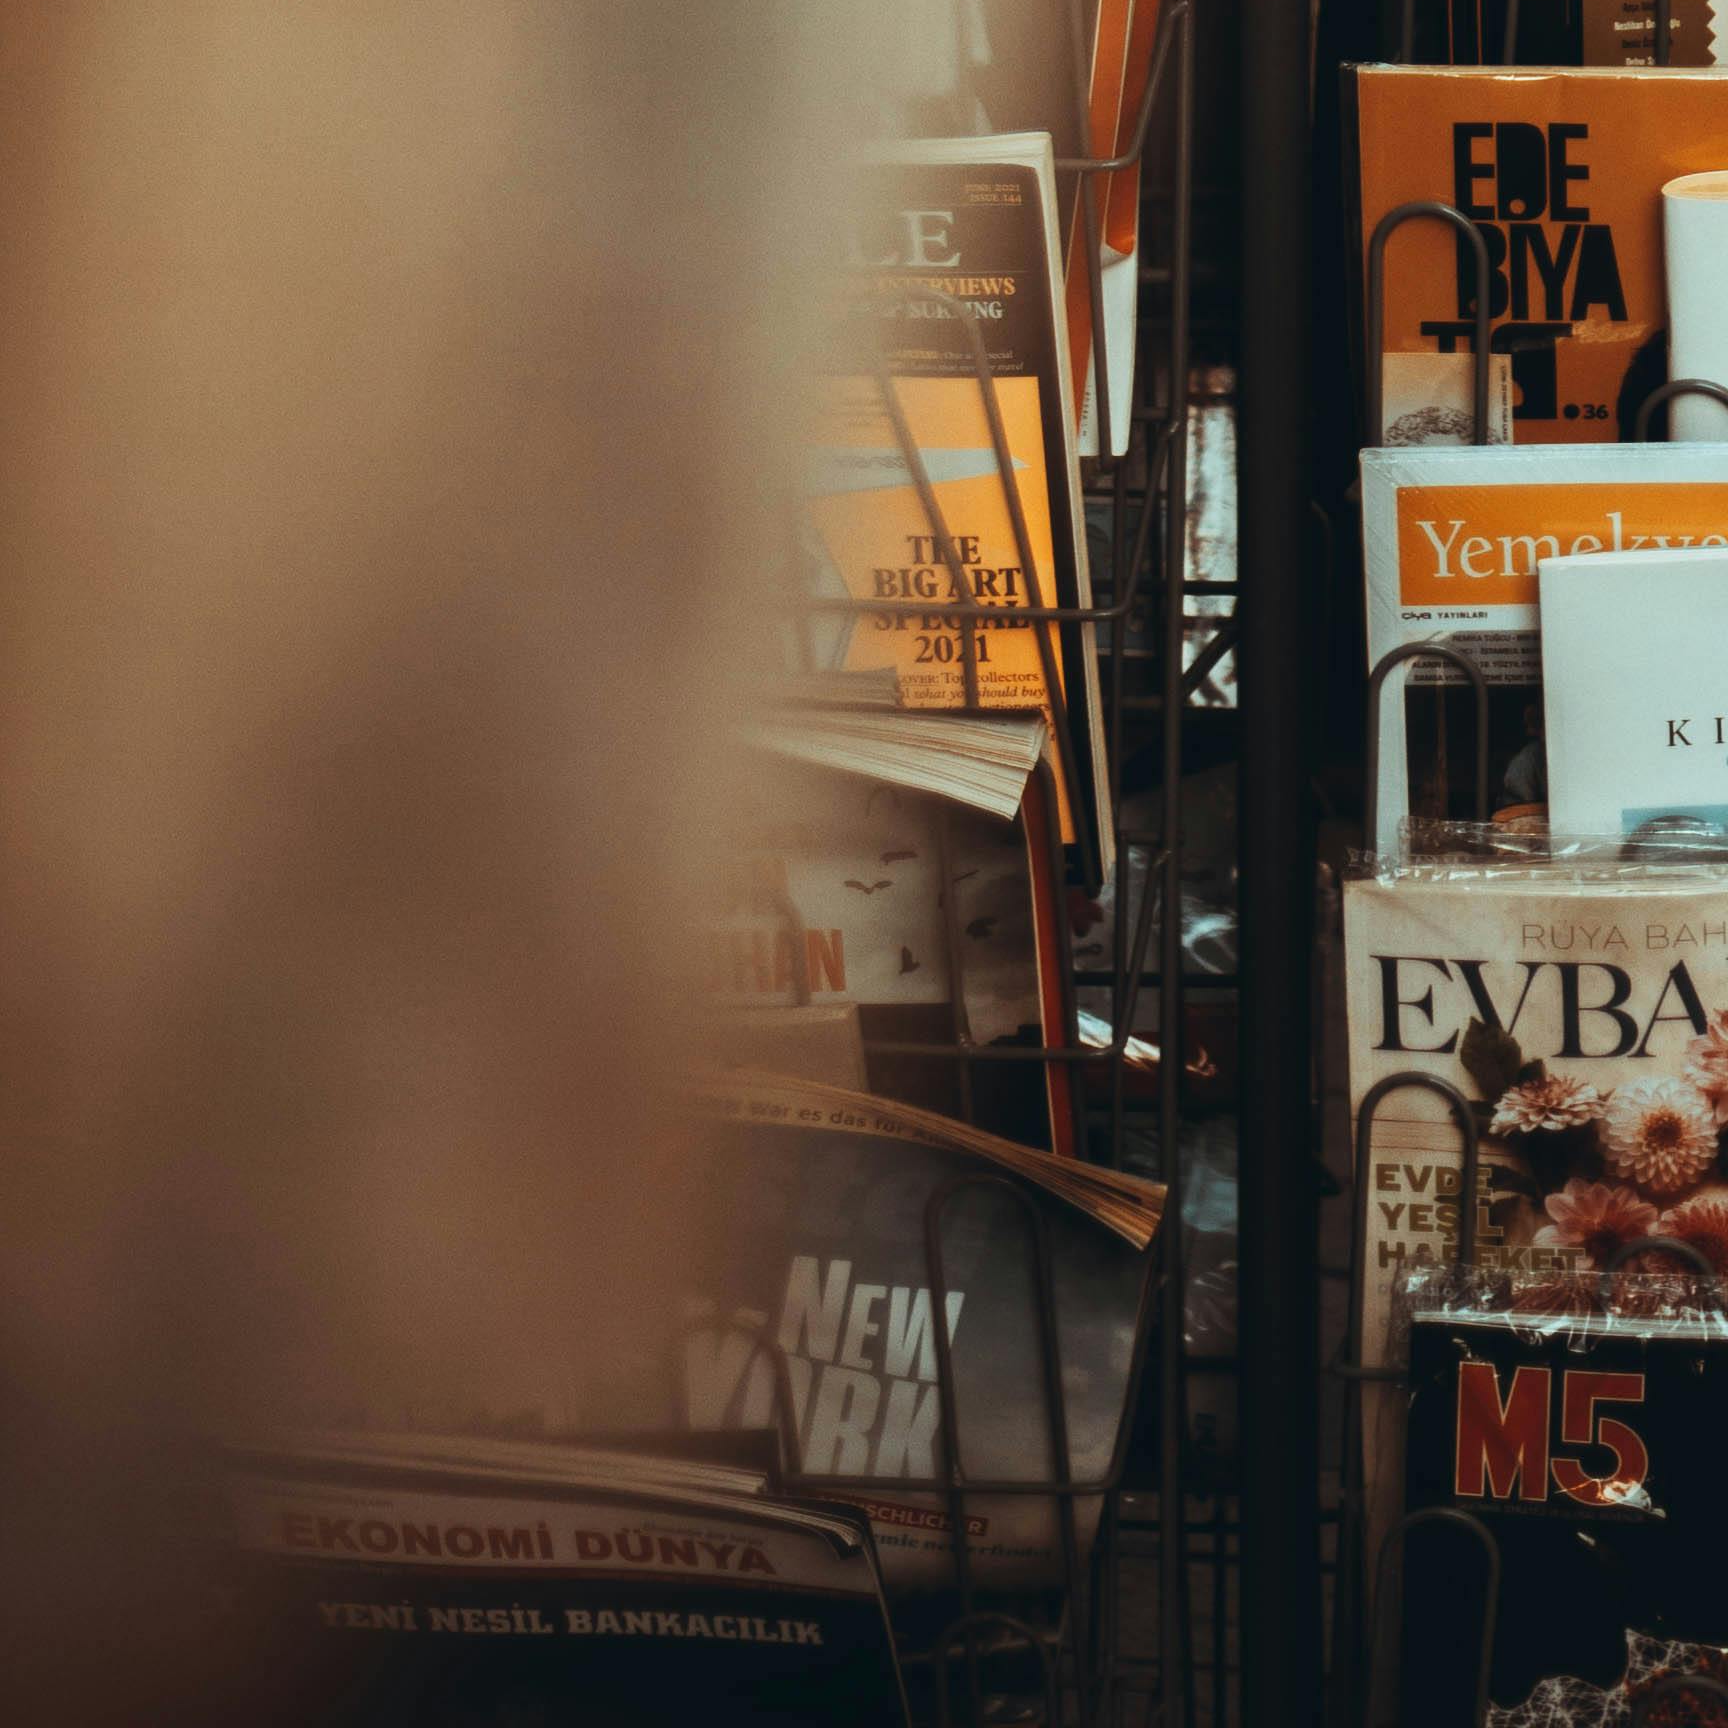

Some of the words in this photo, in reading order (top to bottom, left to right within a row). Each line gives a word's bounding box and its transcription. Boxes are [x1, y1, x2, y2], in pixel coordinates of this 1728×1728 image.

[1453, 121, 1590, 223] EDE
[1584, 402, 1609, 421] 36
[873, 567, 938, 599] BIG
[1437, 611, 1489, 620] YAYINLARI
[1521, 922, 1632, 953] RÜYA
[820, 1104, 855, 1126] das
[777, 1257, 968, 1387] NEW
[1454, 1358, 1649, 1507] M5
[282, 1512, 556, 1562] EKONOMİ
[576, 1524, 778, 1576] DÜNYA
[316, 1599, 418, 1632] YENİ
[426, 1602, 554, 1637] NESİL
[565, 1606, 824, 1647] BANKACILIK
